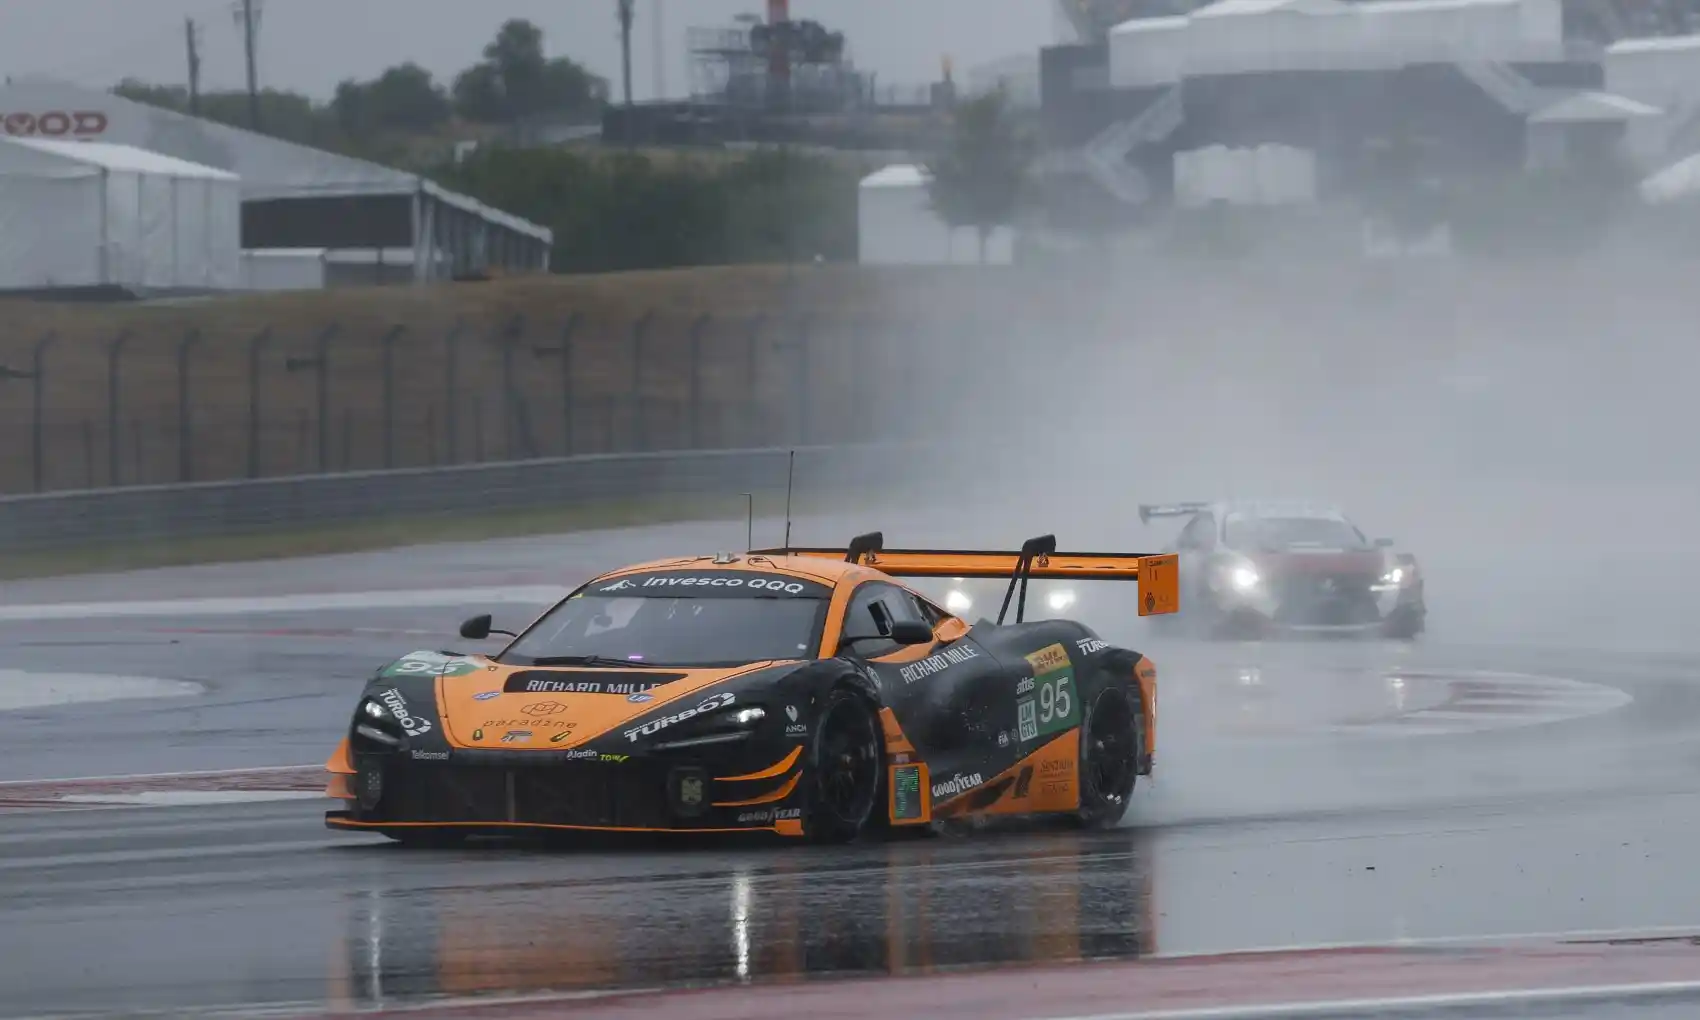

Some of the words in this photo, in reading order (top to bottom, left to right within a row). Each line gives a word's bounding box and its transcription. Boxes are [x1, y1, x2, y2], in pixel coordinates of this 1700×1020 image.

[0, 110, 107, 137] OOD
[642, 576, 744, 588] Invesco
[747, 578, 804, 594] QQQ
[396, 661, 465, 675] 95
[900, 654, 948, 684] RICHARD
[942, 644, 980, 665] MILLE
[526, 679, 600, 693] RICHARD
[380, 689, 415, 729] TURBO
[1040, 677, 1071, 723] 95
[624, 701, 718, 743] TURBO
[411, 749, 450, 760] Telkomsel
[932, 772, 983, 797] GOODYEAR
